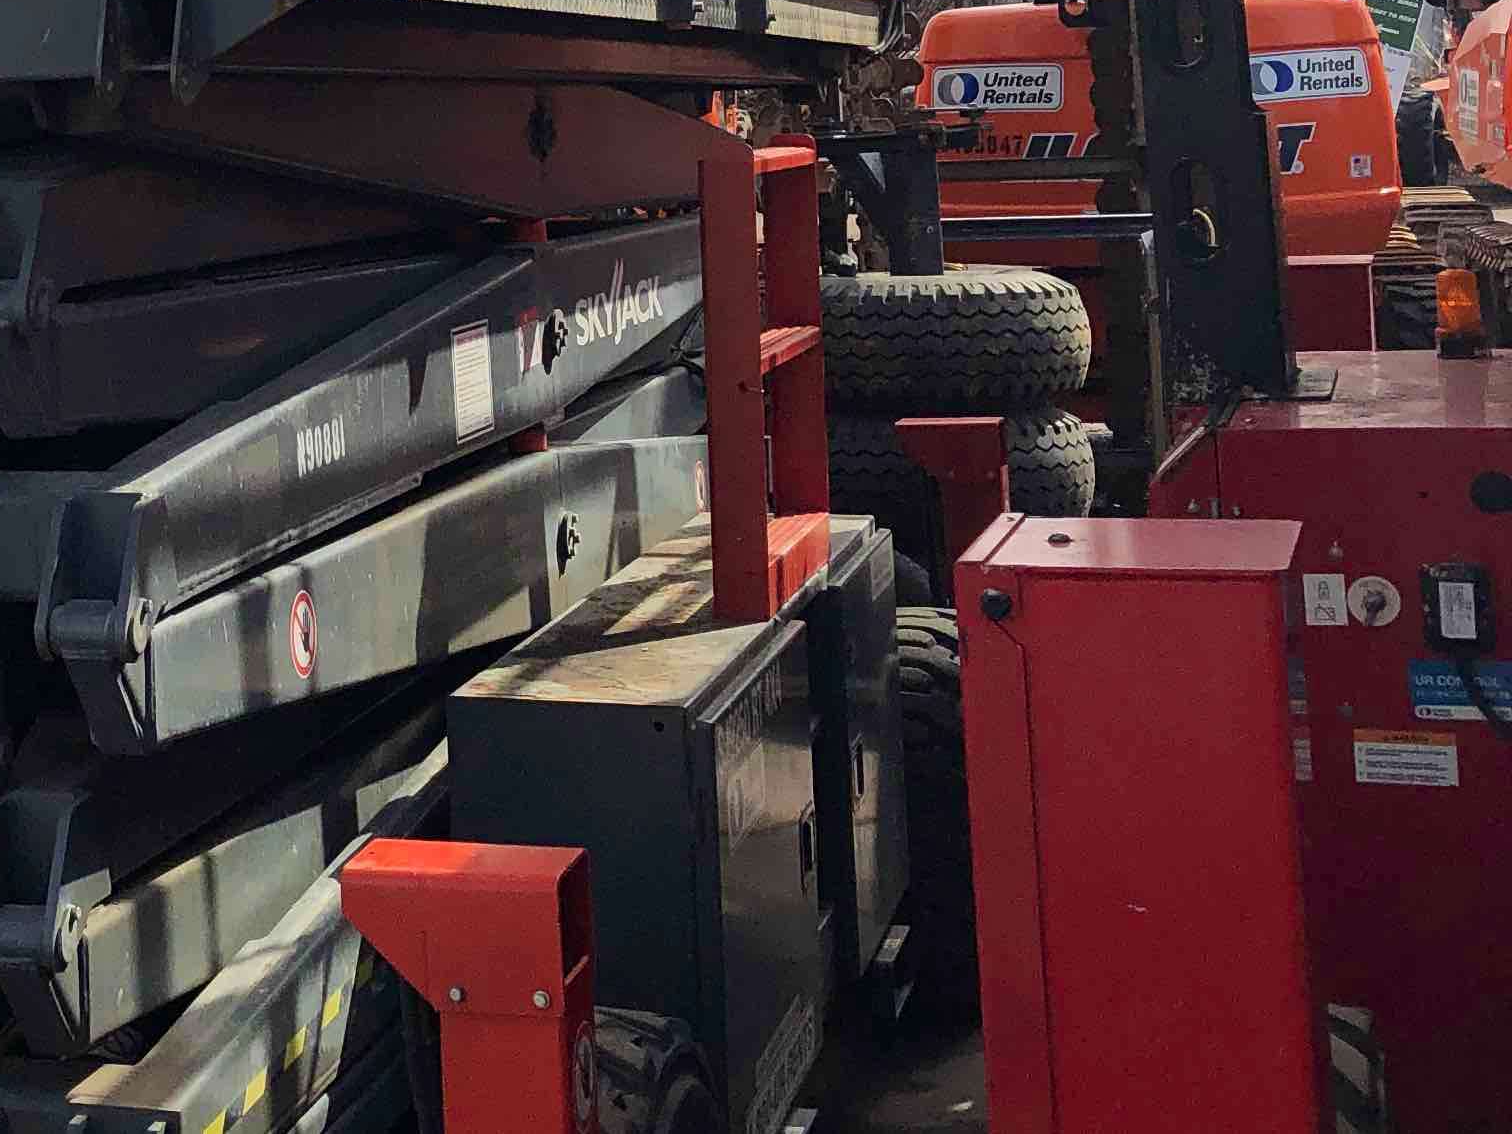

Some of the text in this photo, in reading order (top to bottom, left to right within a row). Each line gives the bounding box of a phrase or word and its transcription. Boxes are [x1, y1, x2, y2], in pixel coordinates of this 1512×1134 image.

[1297, 55, 1355, 74] United
[984, 71, 1049, 87] United
[1300, 73, 1364, 91] Rentals
[982, 88, 1055, 104] Rentals
[574, 258, 664, 346] SKYJACK
